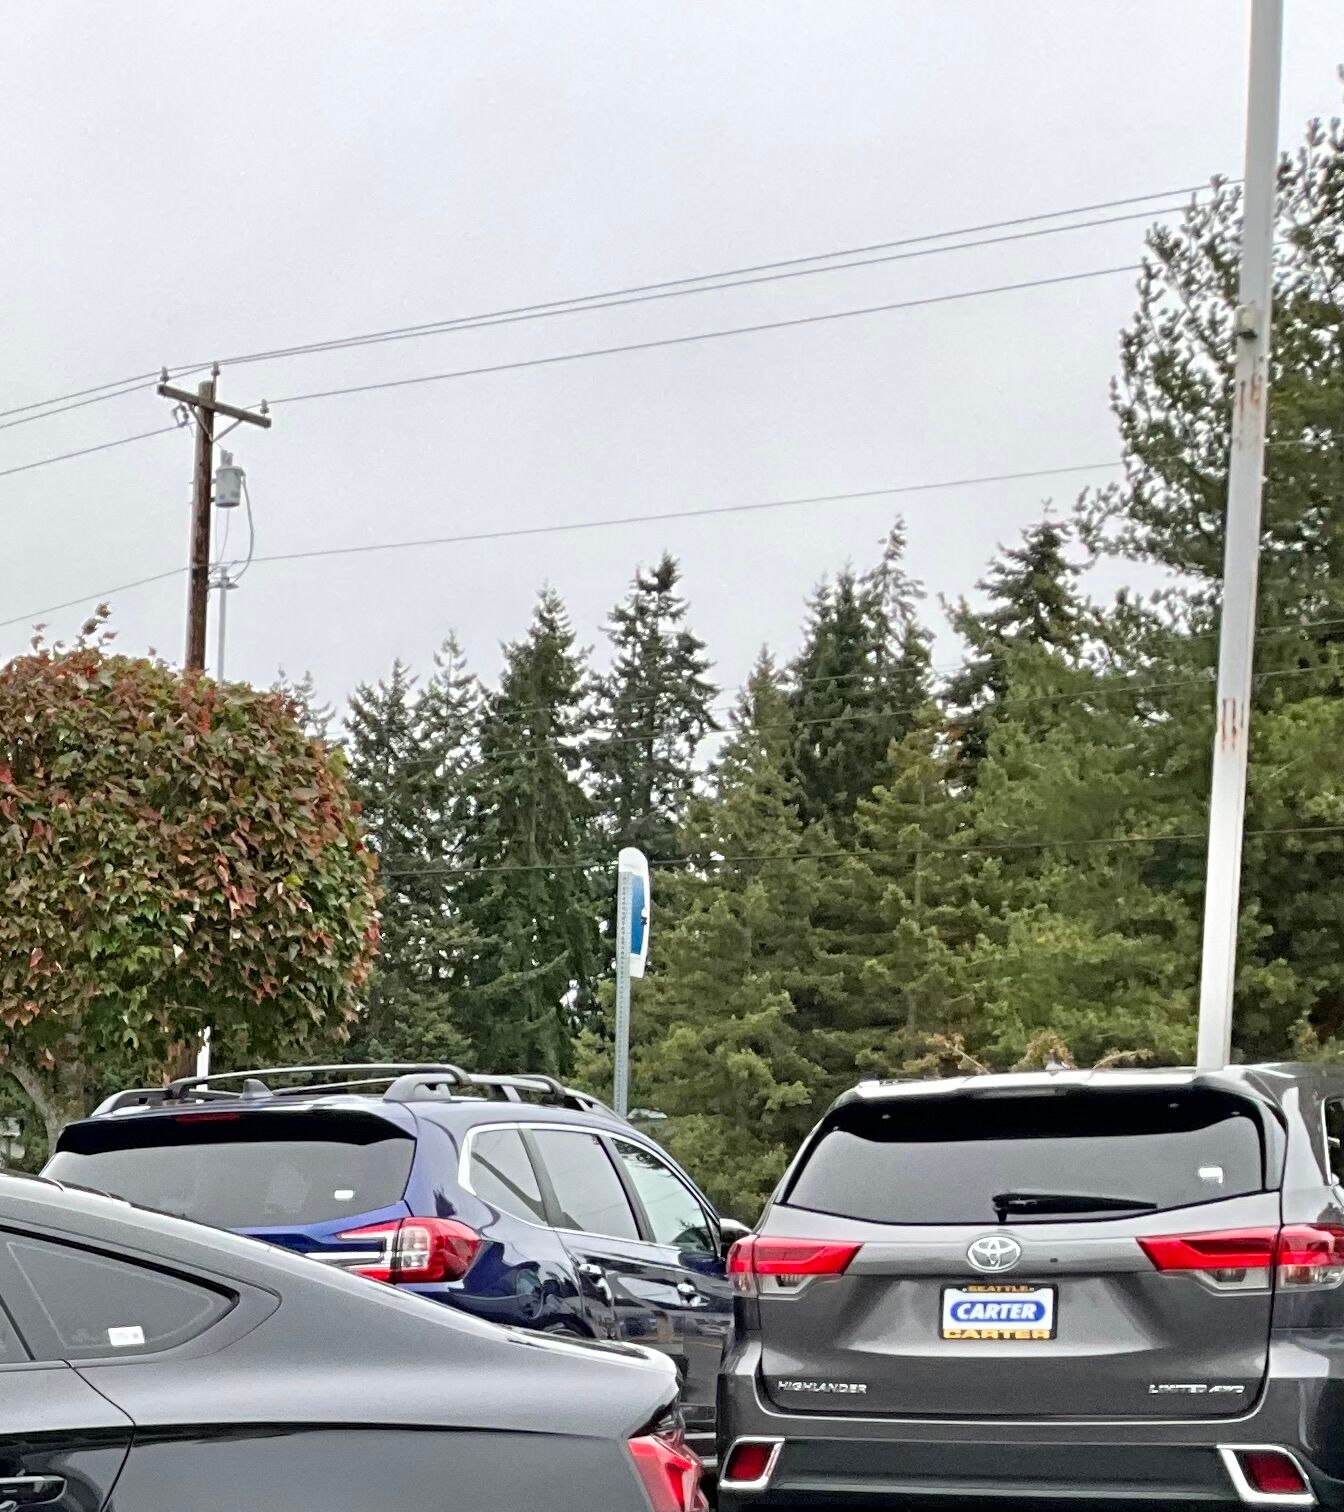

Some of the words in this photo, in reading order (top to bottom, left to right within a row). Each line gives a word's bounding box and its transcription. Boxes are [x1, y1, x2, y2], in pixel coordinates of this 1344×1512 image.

[967, 1284, 1030, 1293] SEATTLE
[956, 1302, 1038, 1320] CARTER
[943, 1329, 1051, 1340] CARTER
[777, 1381, 868, 1394] HIGHLANDER
